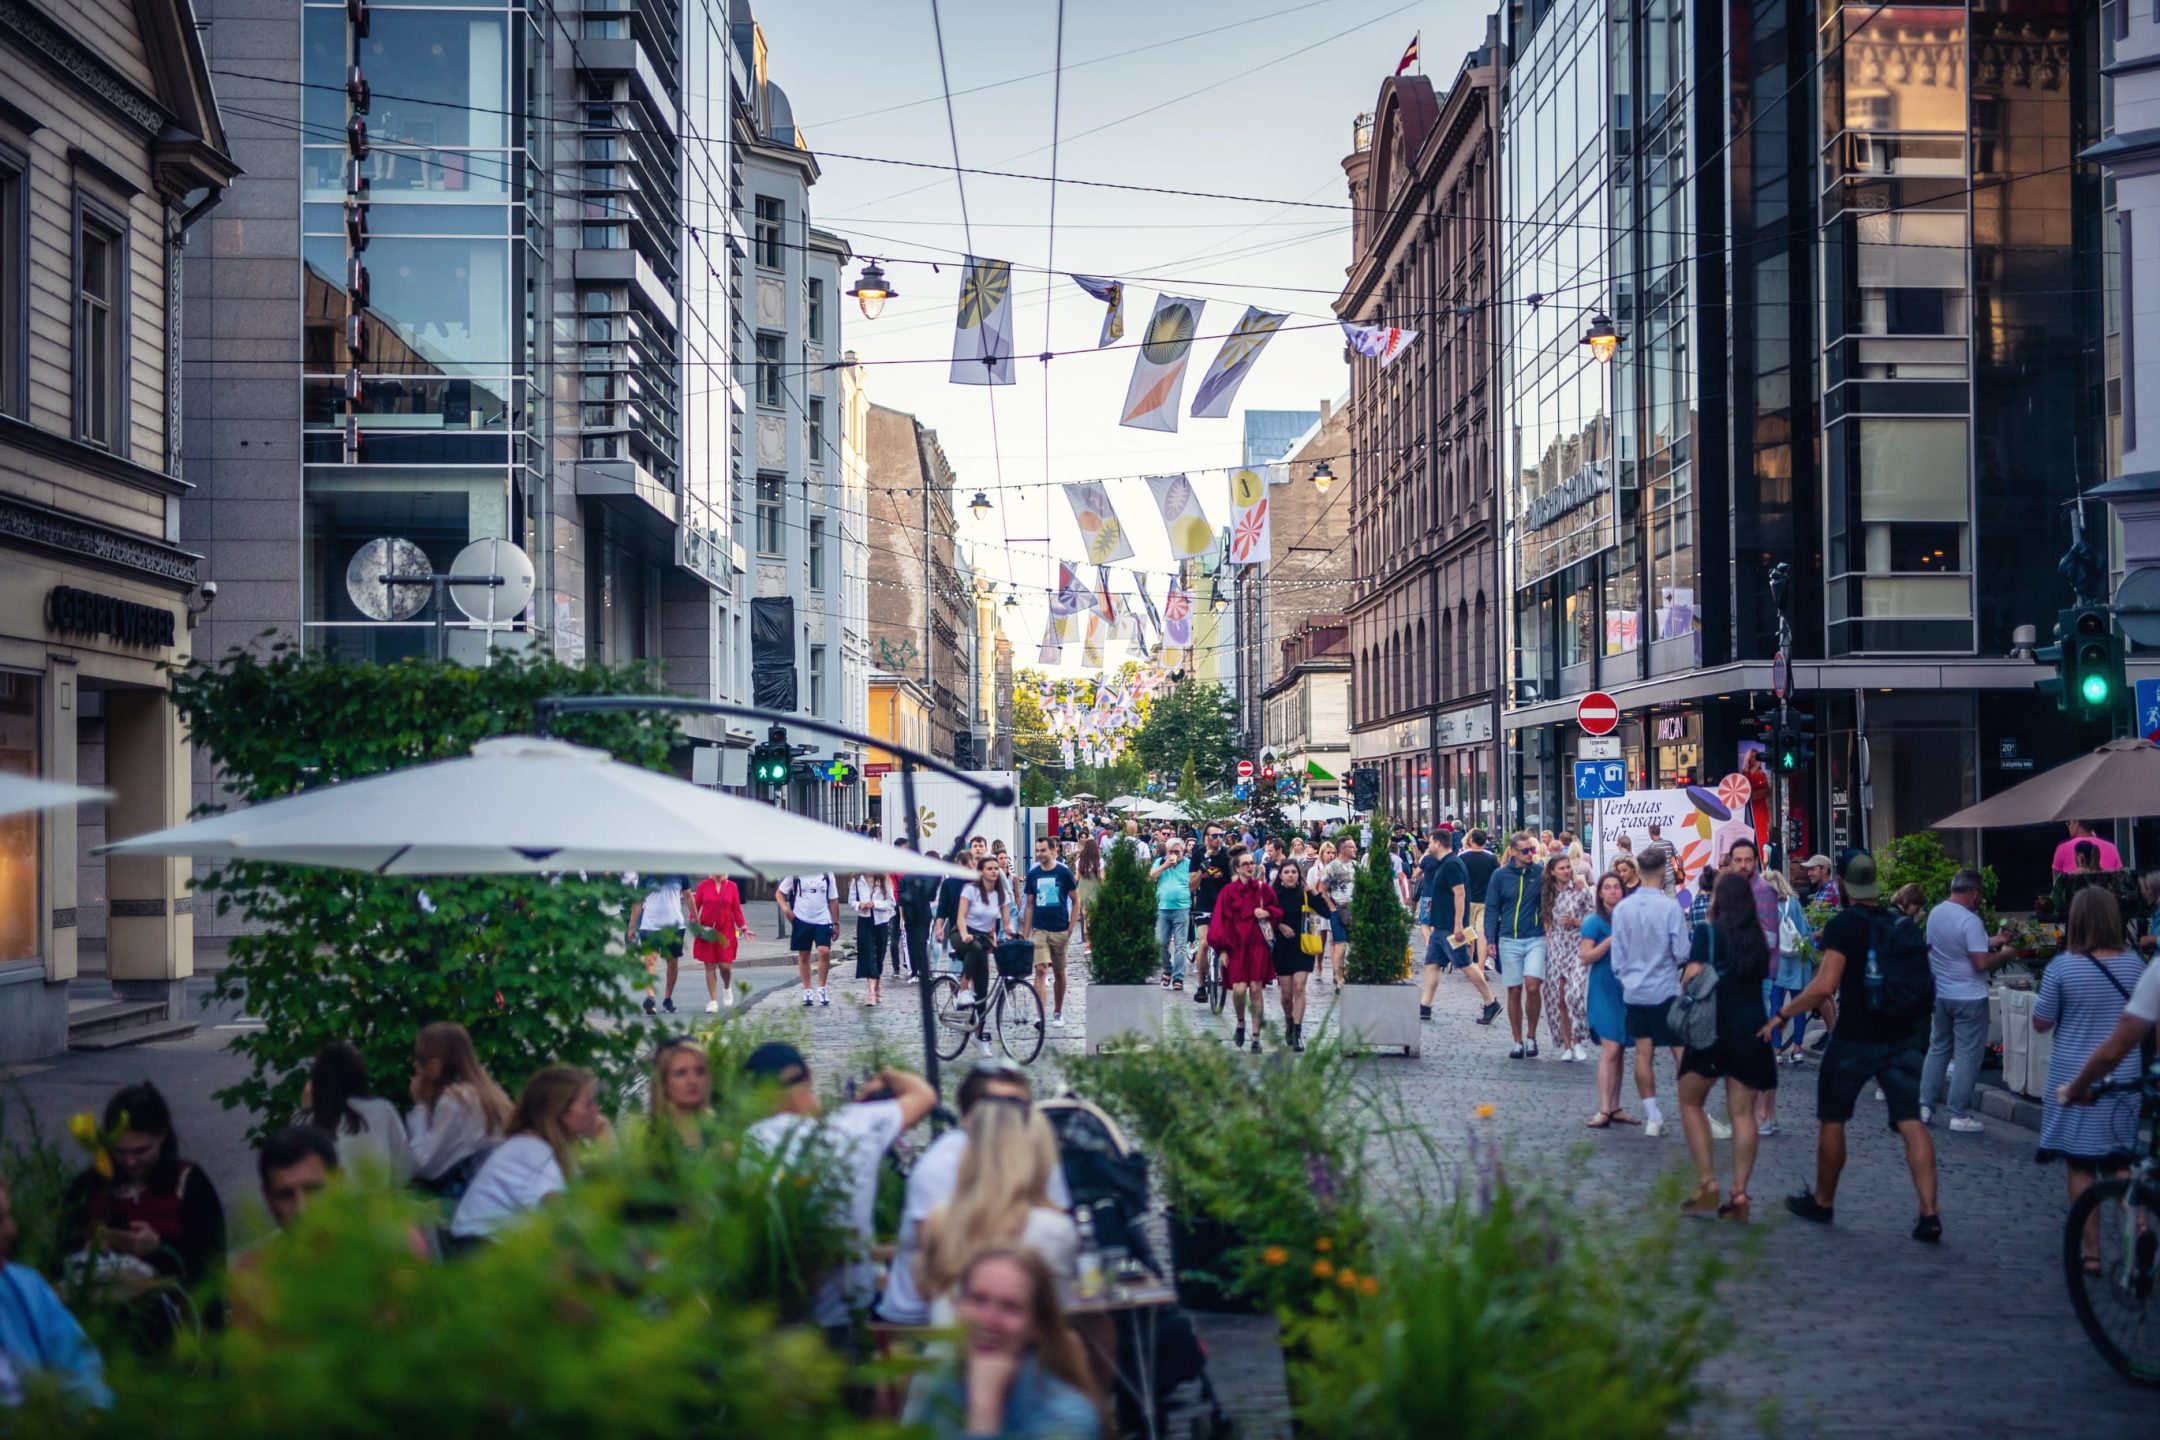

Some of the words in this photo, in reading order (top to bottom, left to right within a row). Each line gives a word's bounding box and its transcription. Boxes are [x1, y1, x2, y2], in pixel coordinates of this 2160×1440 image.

[51, 585, 118, 635] GERRY
[120, 600, 175, 646] WEBER
[1620, 815, 1675, 828] vasaras
